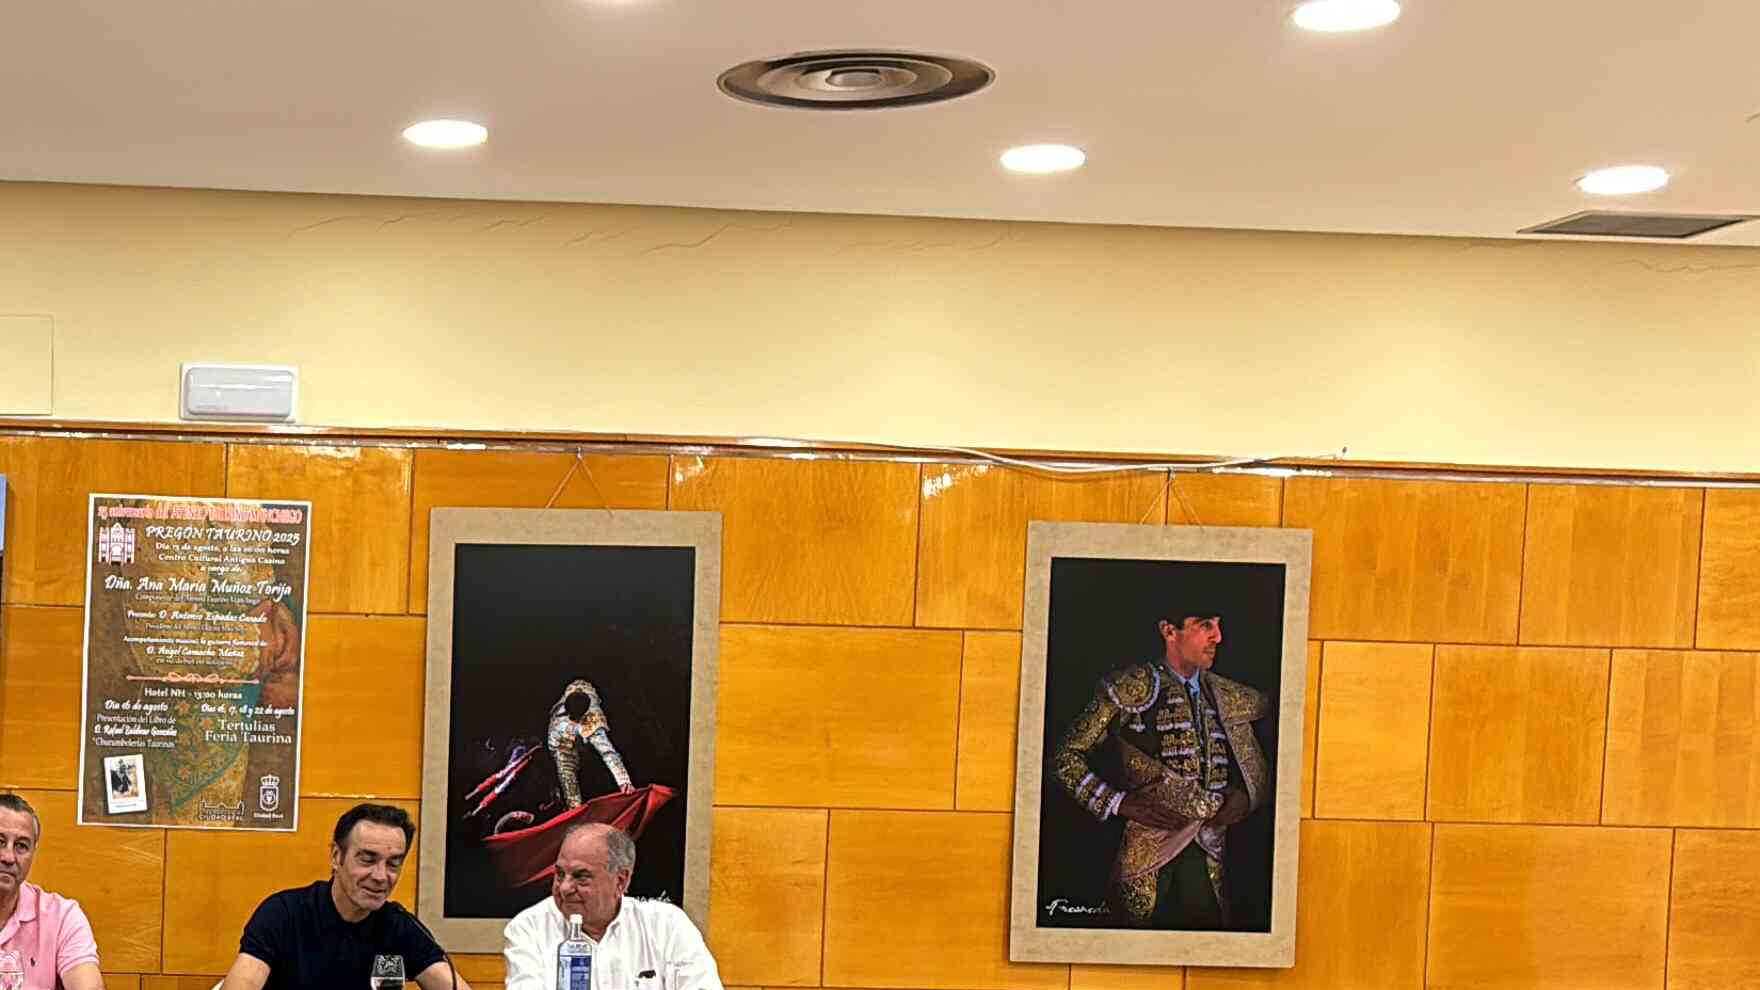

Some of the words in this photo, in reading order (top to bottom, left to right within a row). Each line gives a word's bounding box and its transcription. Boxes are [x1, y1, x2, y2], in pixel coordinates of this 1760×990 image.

[206, 527, 273, 542] TAURINO
[272, 532, 300, 546] 2025
[136, 576, 163, 591] Ana
[211, 579, 252, 594] Muñoz
[256, 580, 292, 602] Torija
[144, 688, 168, 697] Hotel
[171, 689, 186, 697] NH
[218, 690, 243, 699] horas
[143, 702, 168, 716] agosto
[217, 719, 276, 732] Tertulias
[205, 730, 238, 742] Feria
[241, 731, 292, 745] Taurina
